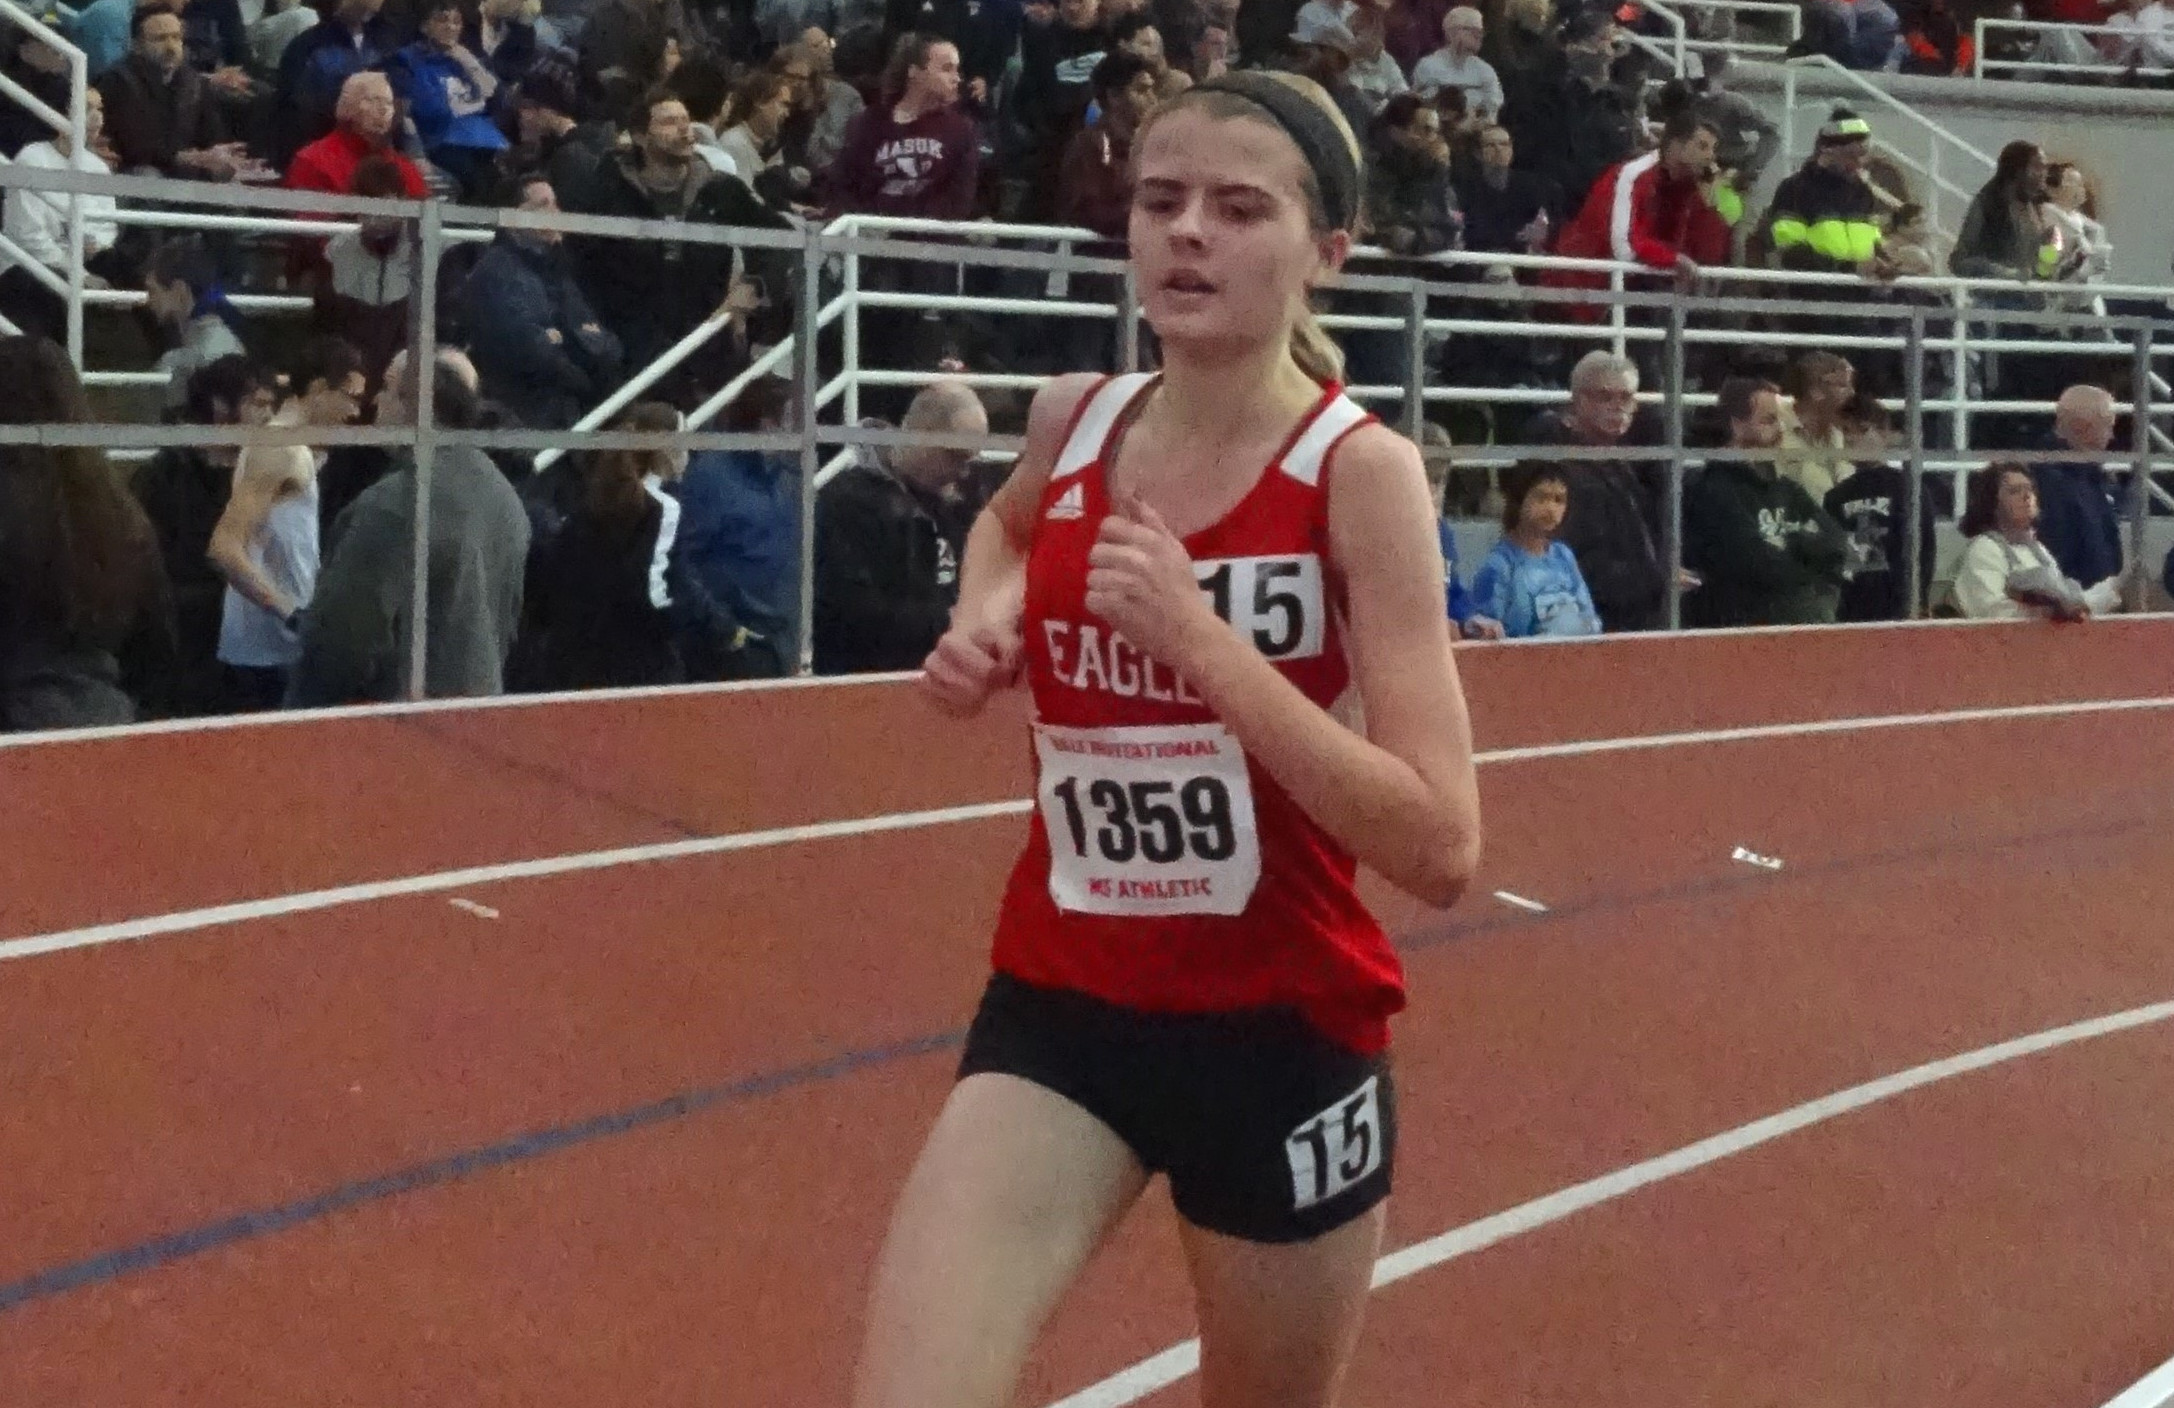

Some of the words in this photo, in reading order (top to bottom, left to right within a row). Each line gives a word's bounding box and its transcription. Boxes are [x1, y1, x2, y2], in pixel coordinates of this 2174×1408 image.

[1197, 561, 1305, 657] 15
[1054, 775, 1237, 864] 1359
[1118, 876, 1213, 899] ATHLETIC
[1291, 1090, 1371, 1200] 15
